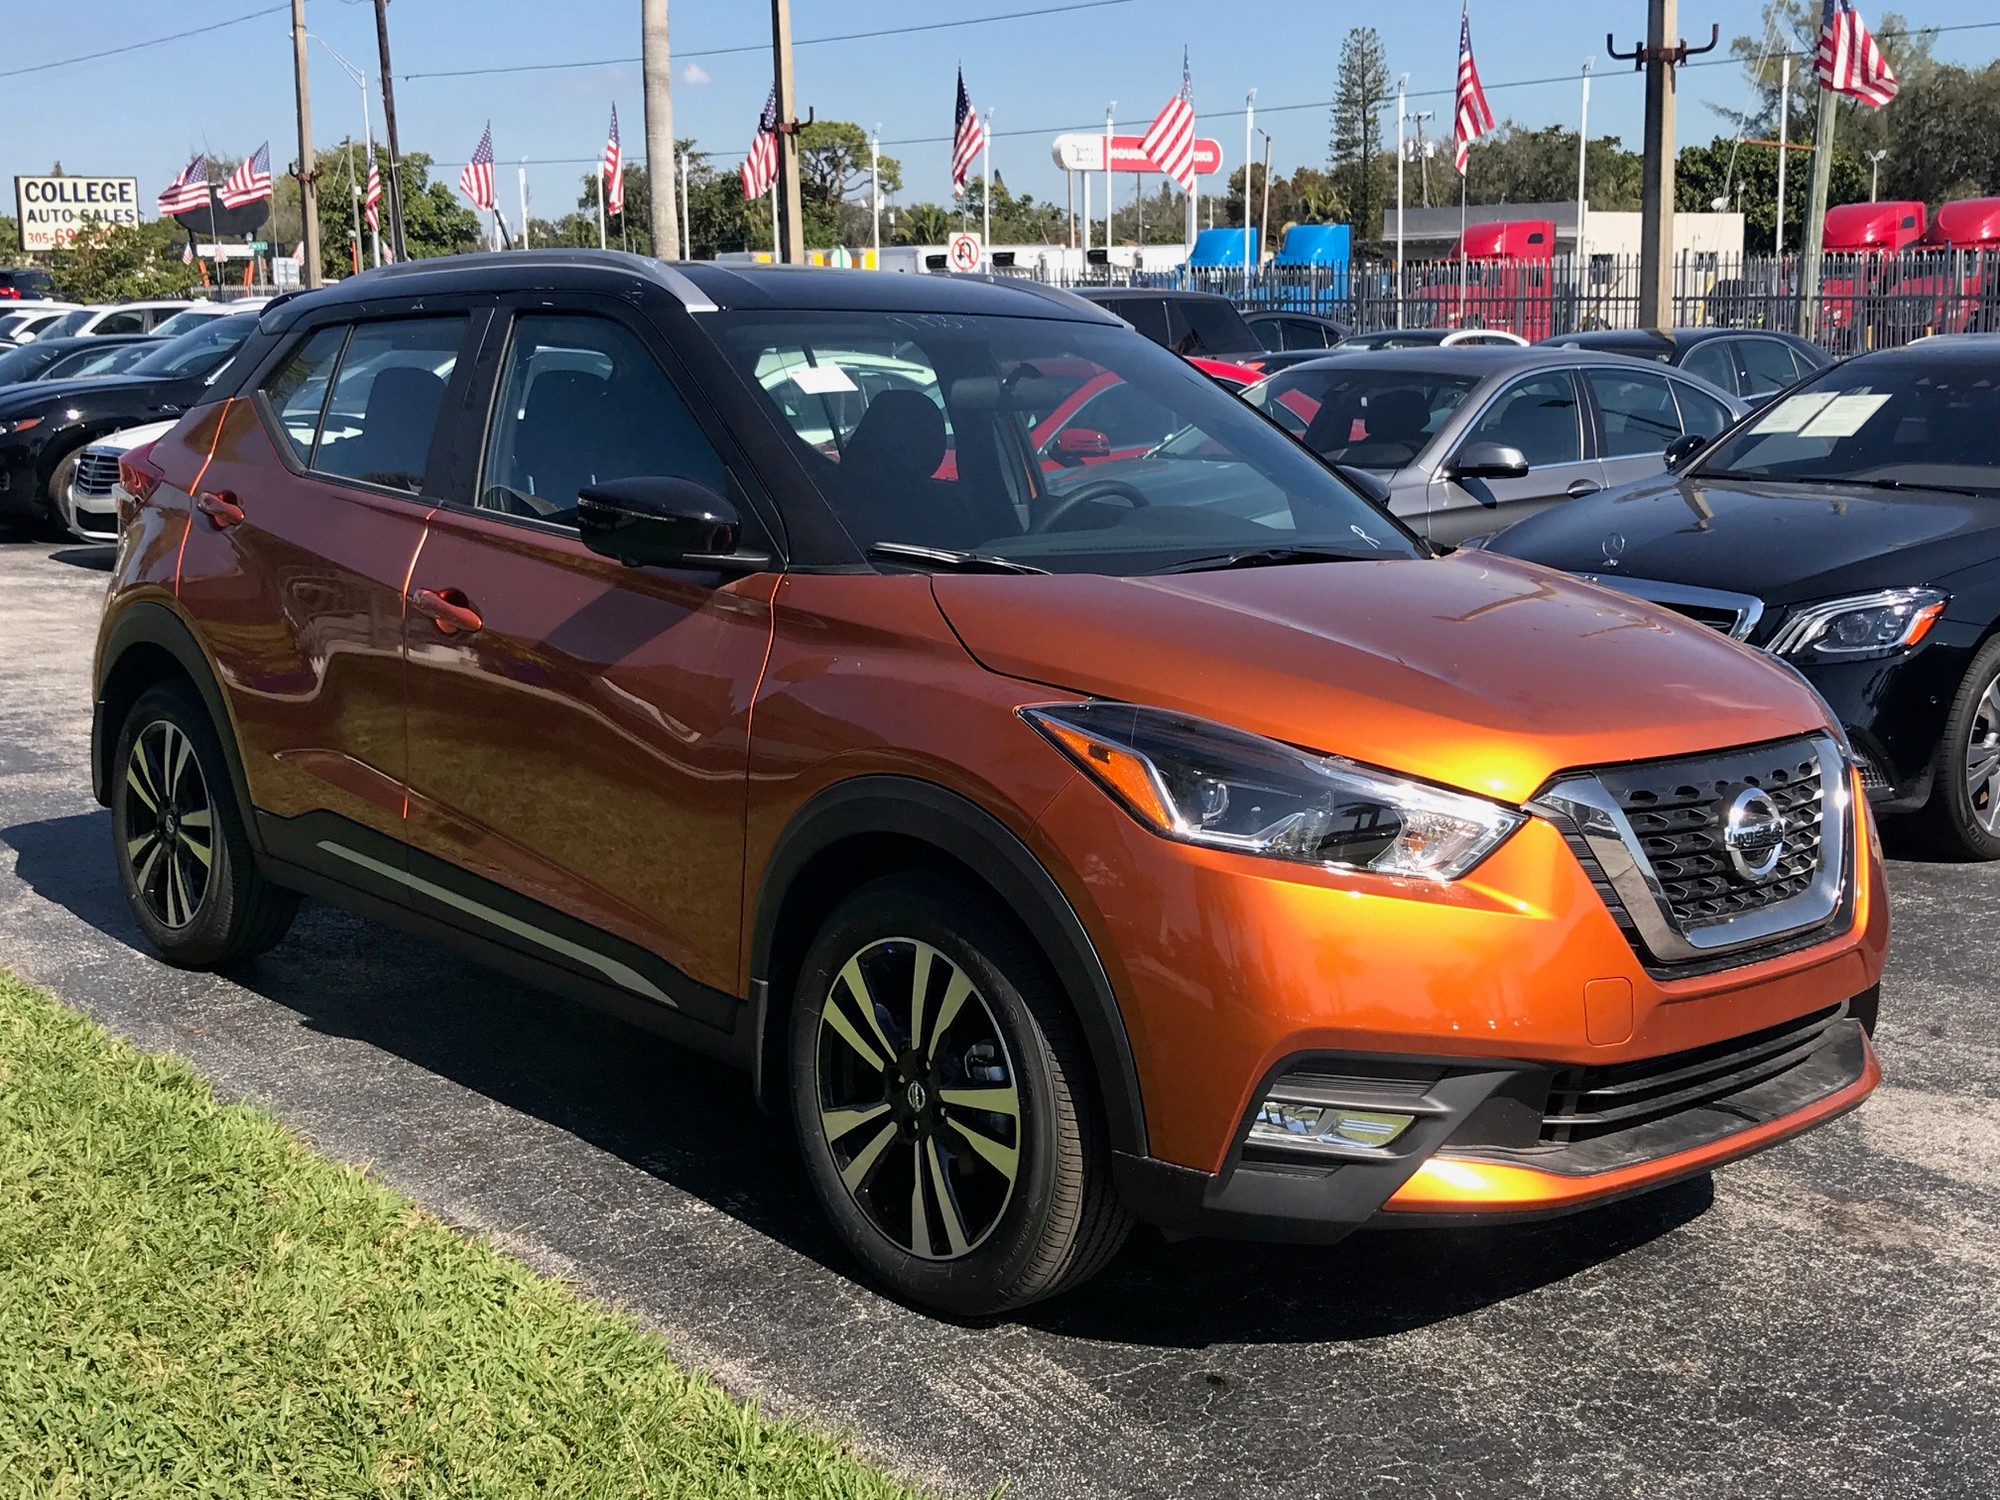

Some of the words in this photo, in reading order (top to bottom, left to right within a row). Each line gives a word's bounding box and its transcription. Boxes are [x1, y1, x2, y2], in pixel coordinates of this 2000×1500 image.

[25, 181, 133, 203] COLLEGE
[27, 208, 73, 223] AUTO
[80, 208, 135, 223] SALES
